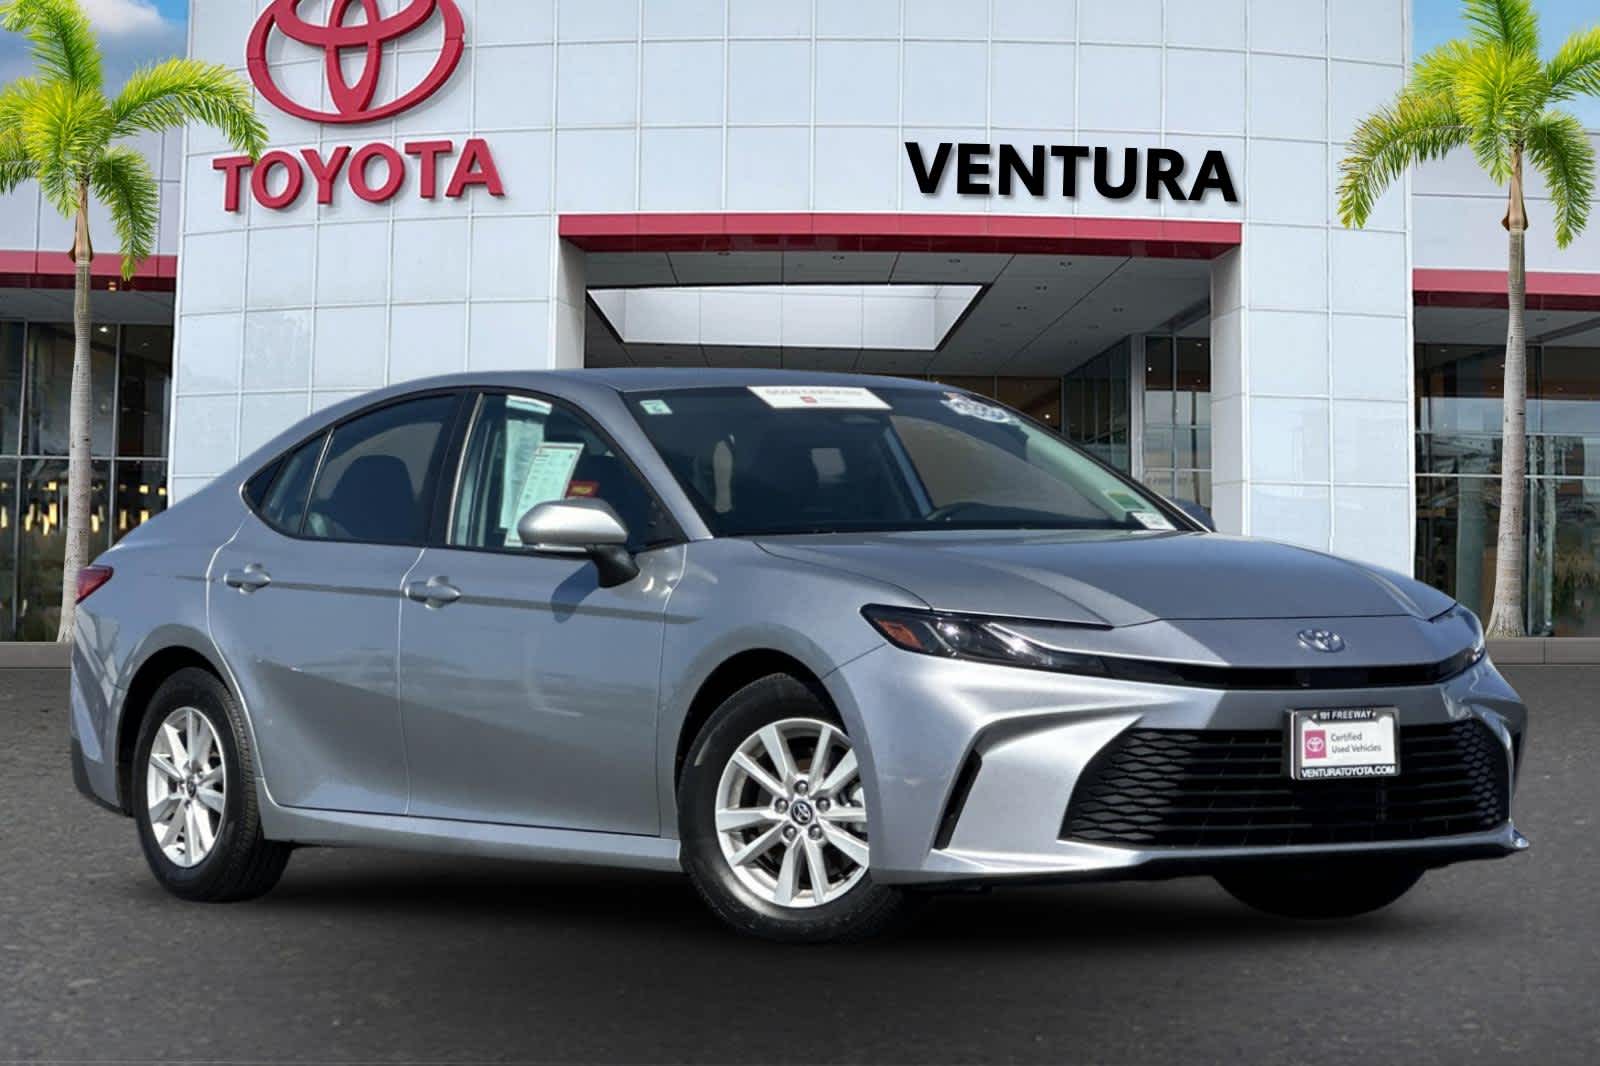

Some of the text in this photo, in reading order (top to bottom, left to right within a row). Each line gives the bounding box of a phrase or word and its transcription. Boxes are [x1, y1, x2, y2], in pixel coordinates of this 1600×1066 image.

[213, 138, 505, 213] TOYOTA
[904, 141, 1238, 203] VENTURA
[1332, 711, 1371, 719] FREEWAY
[1331, 732, 1362, 742] Certified
[1332, 744, 1382, 753] Used Vehicles
[1301, 765, 1395, 777] VENTURATOYOTA.COM
